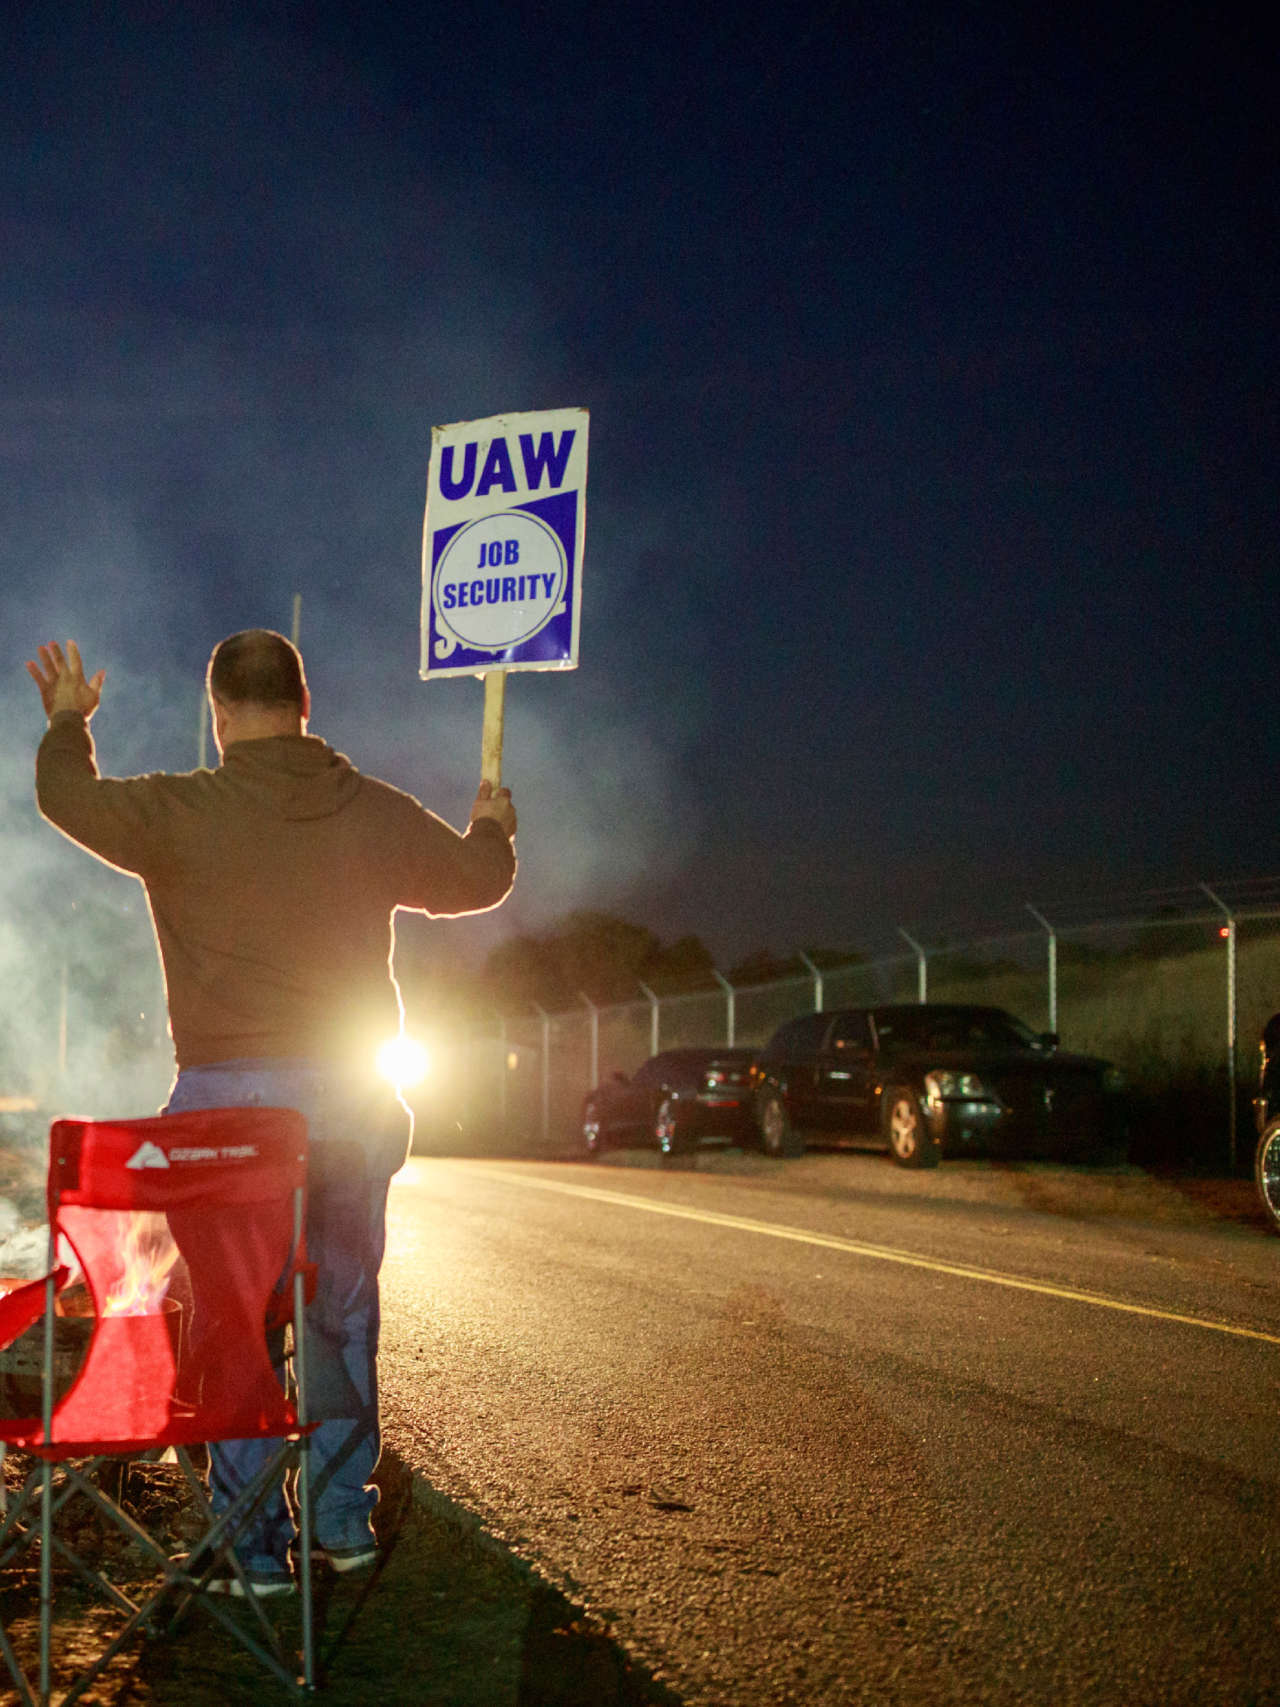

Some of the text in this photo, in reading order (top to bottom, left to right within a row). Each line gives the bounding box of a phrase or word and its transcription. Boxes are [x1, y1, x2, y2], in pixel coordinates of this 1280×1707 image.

[439, 430, 577, 501] UAW
[477, 539, 519, 568] JOB
[443, 572, 557, 609] SECURITY
